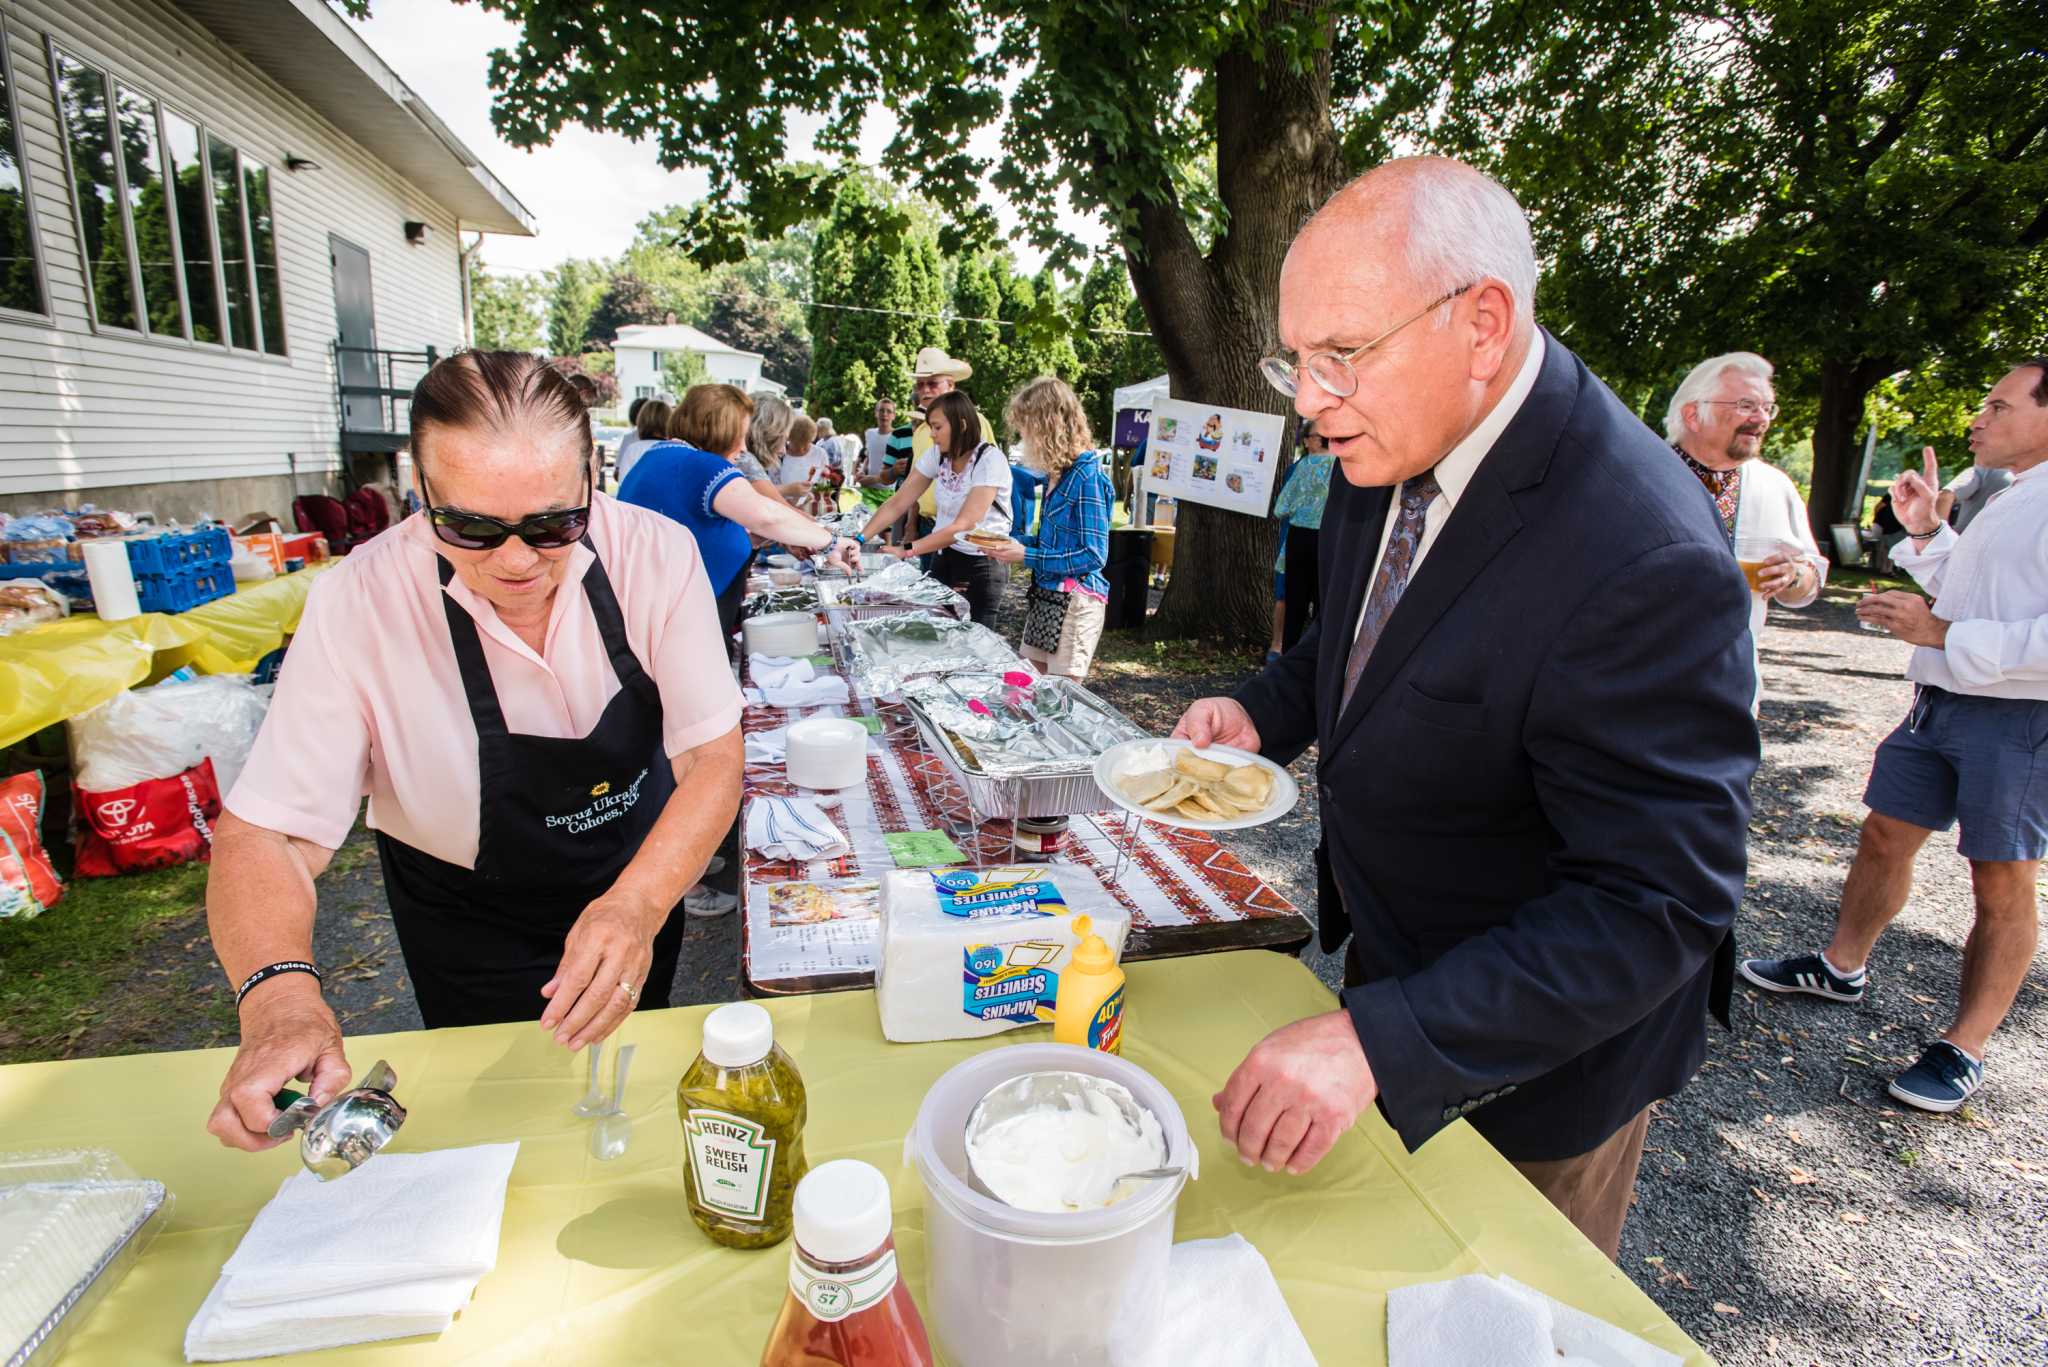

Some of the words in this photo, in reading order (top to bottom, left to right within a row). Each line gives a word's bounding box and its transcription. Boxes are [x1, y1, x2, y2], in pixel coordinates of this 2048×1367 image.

[544, 807, 593, 828] Soyuz
[567, 807, 623, 833] Cohoes,
[945, 878, 972, 887] 160
[953, 884, 1039, 905] SERVIETTES
[974, 959, 997, 970] 160
[974, 974, 1046, 1000] SERVIETTES
[982, 999, 1038, 1021] NAPKINS
[701, 1121, 748, 1142] HEINZ
[705, 1145, 747, 1163] SWEET
[706, 1155, 748, 1173] RELISH
[817, 1284, 841, 1293] HEINZ
[818, 1293, 838, 1305] 57
